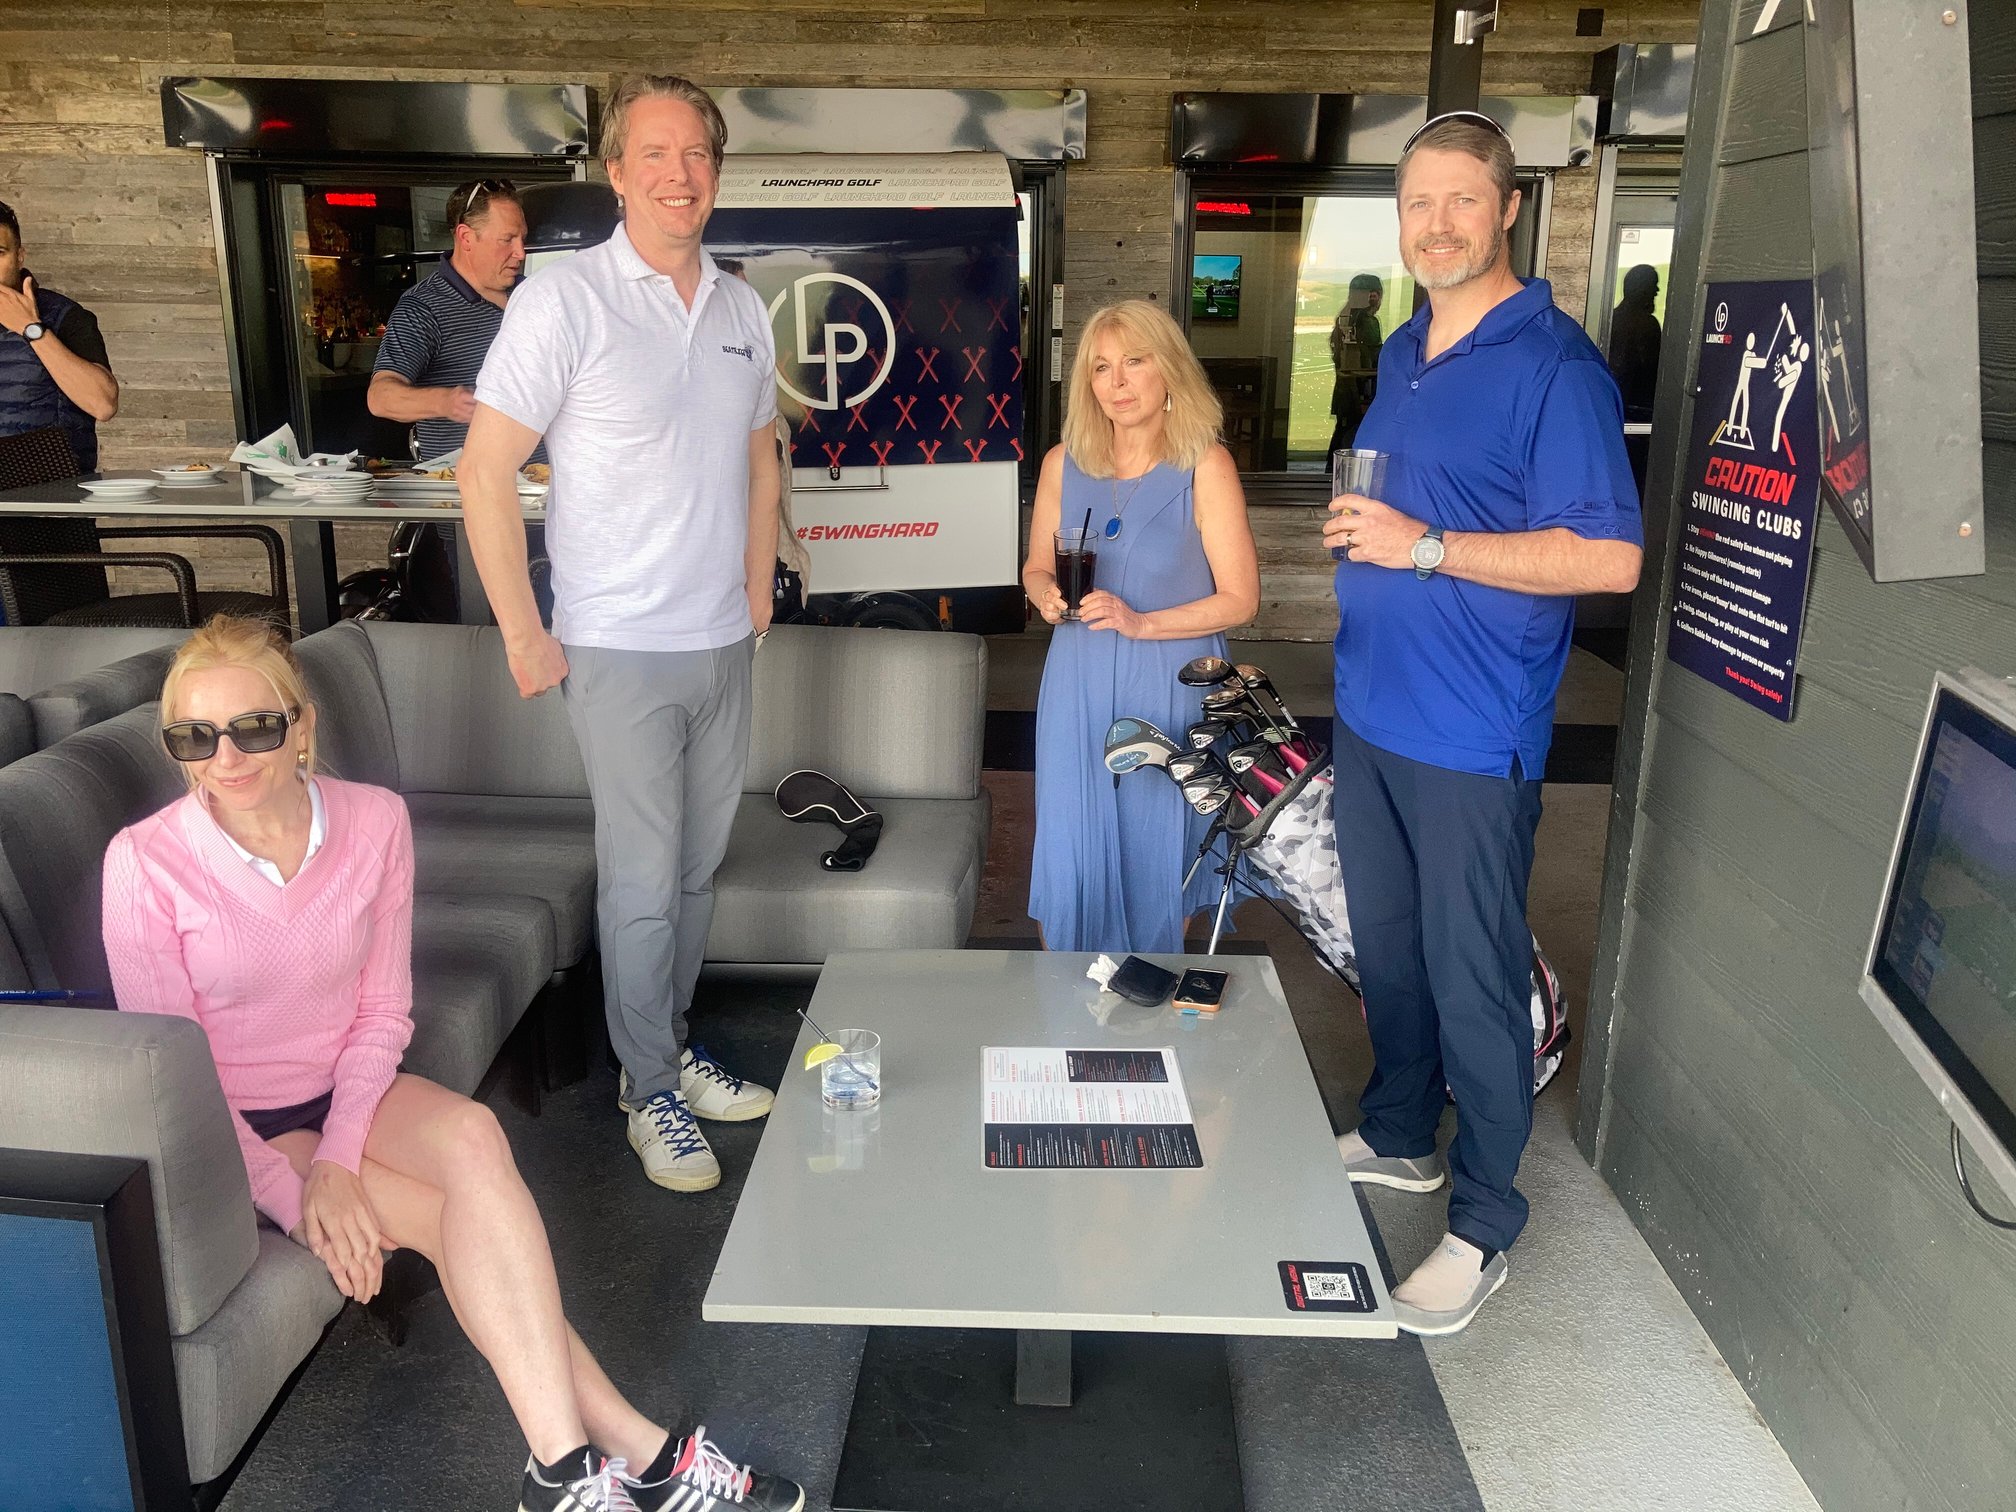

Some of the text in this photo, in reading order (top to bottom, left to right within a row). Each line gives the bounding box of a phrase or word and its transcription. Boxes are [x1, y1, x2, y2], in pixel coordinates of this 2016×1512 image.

[761, 179, 882, 187] LAUNCHPAD GOLF
[782, 192, 819, 202] GOLF
[824, 192, 945, 201] LAUNCHPAD GOLF
[1704, 456, 1797, 506] CAUTION
[1692, 491, 1802, 540] SWINGING CLUBS
[796, 522, 939, 541] #SWINGHARD
[1149, 728, 1183, 751] TaylorM
